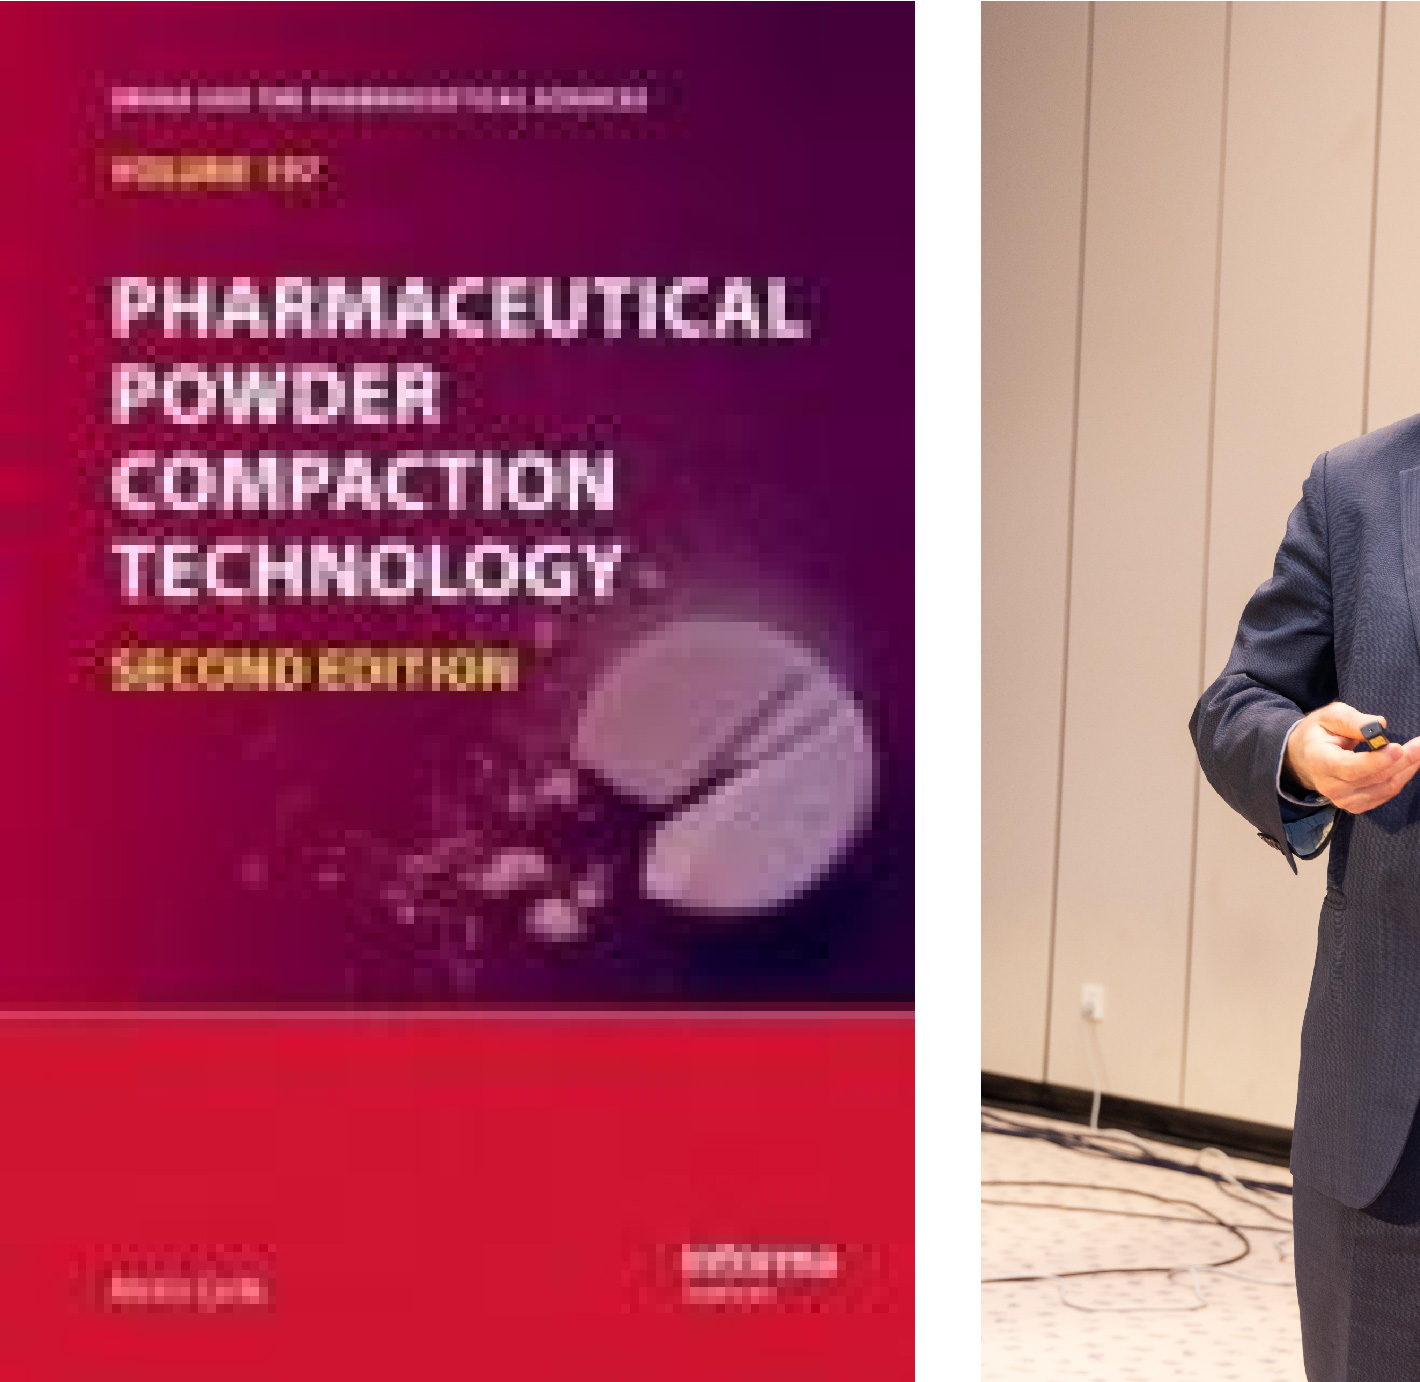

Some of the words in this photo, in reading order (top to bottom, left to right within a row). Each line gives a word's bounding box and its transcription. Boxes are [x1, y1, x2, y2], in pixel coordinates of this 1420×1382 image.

[111, 276, 812, 339] PHARMACEUTICAL
[111, 362, 441, 425] POWDER
[111, 449, 614, 511] COMPACTION
[111, 536, 622, 598] TECHNOLOGY
[111, 647, 304, 692] SECOND
[318, 647, 519, 692] EDITION
